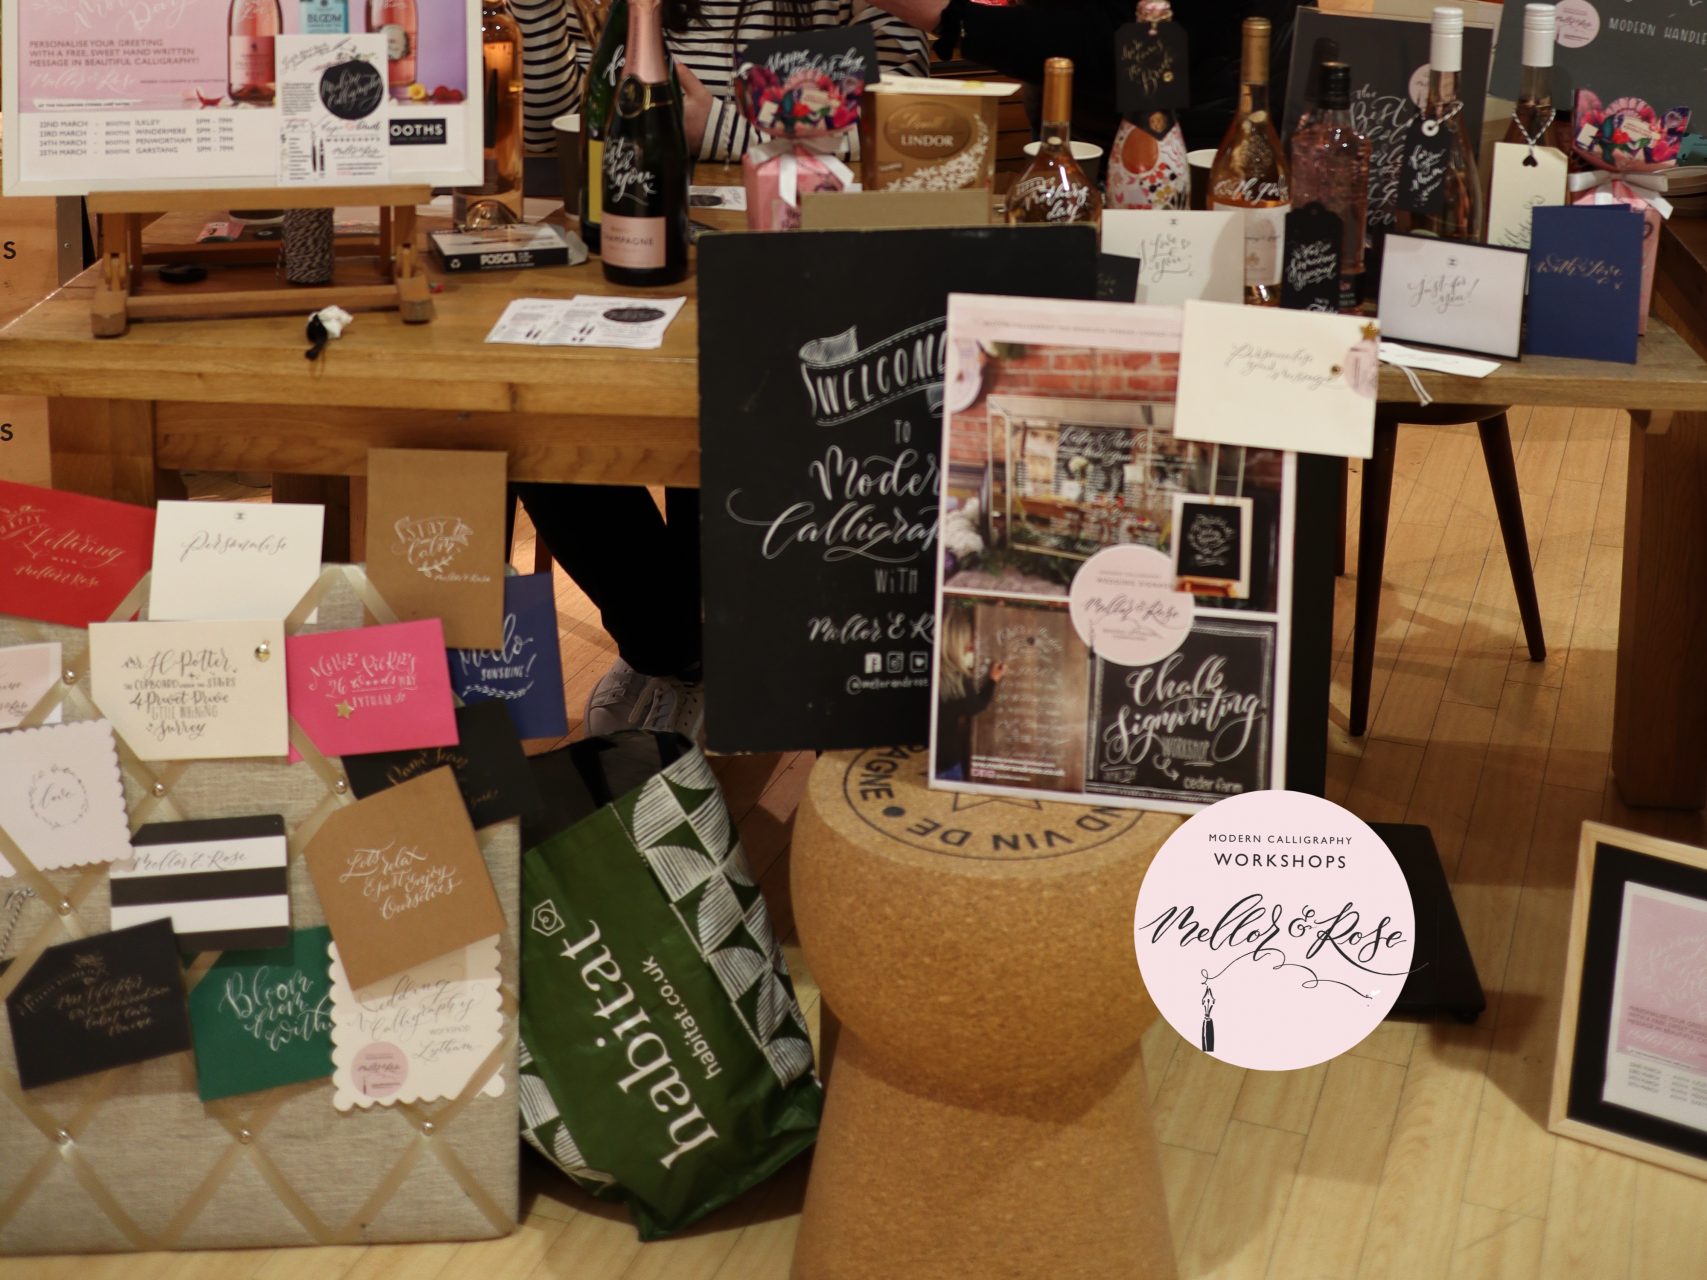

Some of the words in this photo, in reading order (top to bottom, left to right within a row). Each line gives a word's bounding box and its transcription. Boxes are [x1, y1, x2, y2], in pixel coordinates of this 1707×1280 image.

[1608, 17, 1656, 37] MODERN
[29, 40, 89, 48] PERSONALISE
[89, 39, 115, 47] YOUR
[118, 39, 163, 47] GREETING
[29, 49, 54, 57] WITH
[56, 49, 63, 57] A
[91, 48, 120, 56] SWEET
[123, 48, 151, 56] HAND
[152, 47, 195, 55] WRITTEN
[29, 58, 70, 67] MESSAGE
[71, 58, 82, 66] IN
[84, 57, 133, 66] BEAUTIFUL
[60, 120, 88, 128] MARCH
[390, 123, 444, 138] OOTHS
[901, 135, 953, 147] LINDOR
[60, 148, 87, 156] MARCH
[480, 253, 517, 266] POSCA
[894, 419, 911, 445] TO
[809, 444, 941, 502] Moder
[1126, 652, 1230, 707] Chalk
[1103, 686, 1267, 765] Signwriting
[907, 818, 971, 848] DE
[993, 829, 1072, 851] VIN
[641, 955, 723, 1081] habitat.co.uk
[559, 918, 719, 1170] habitat
